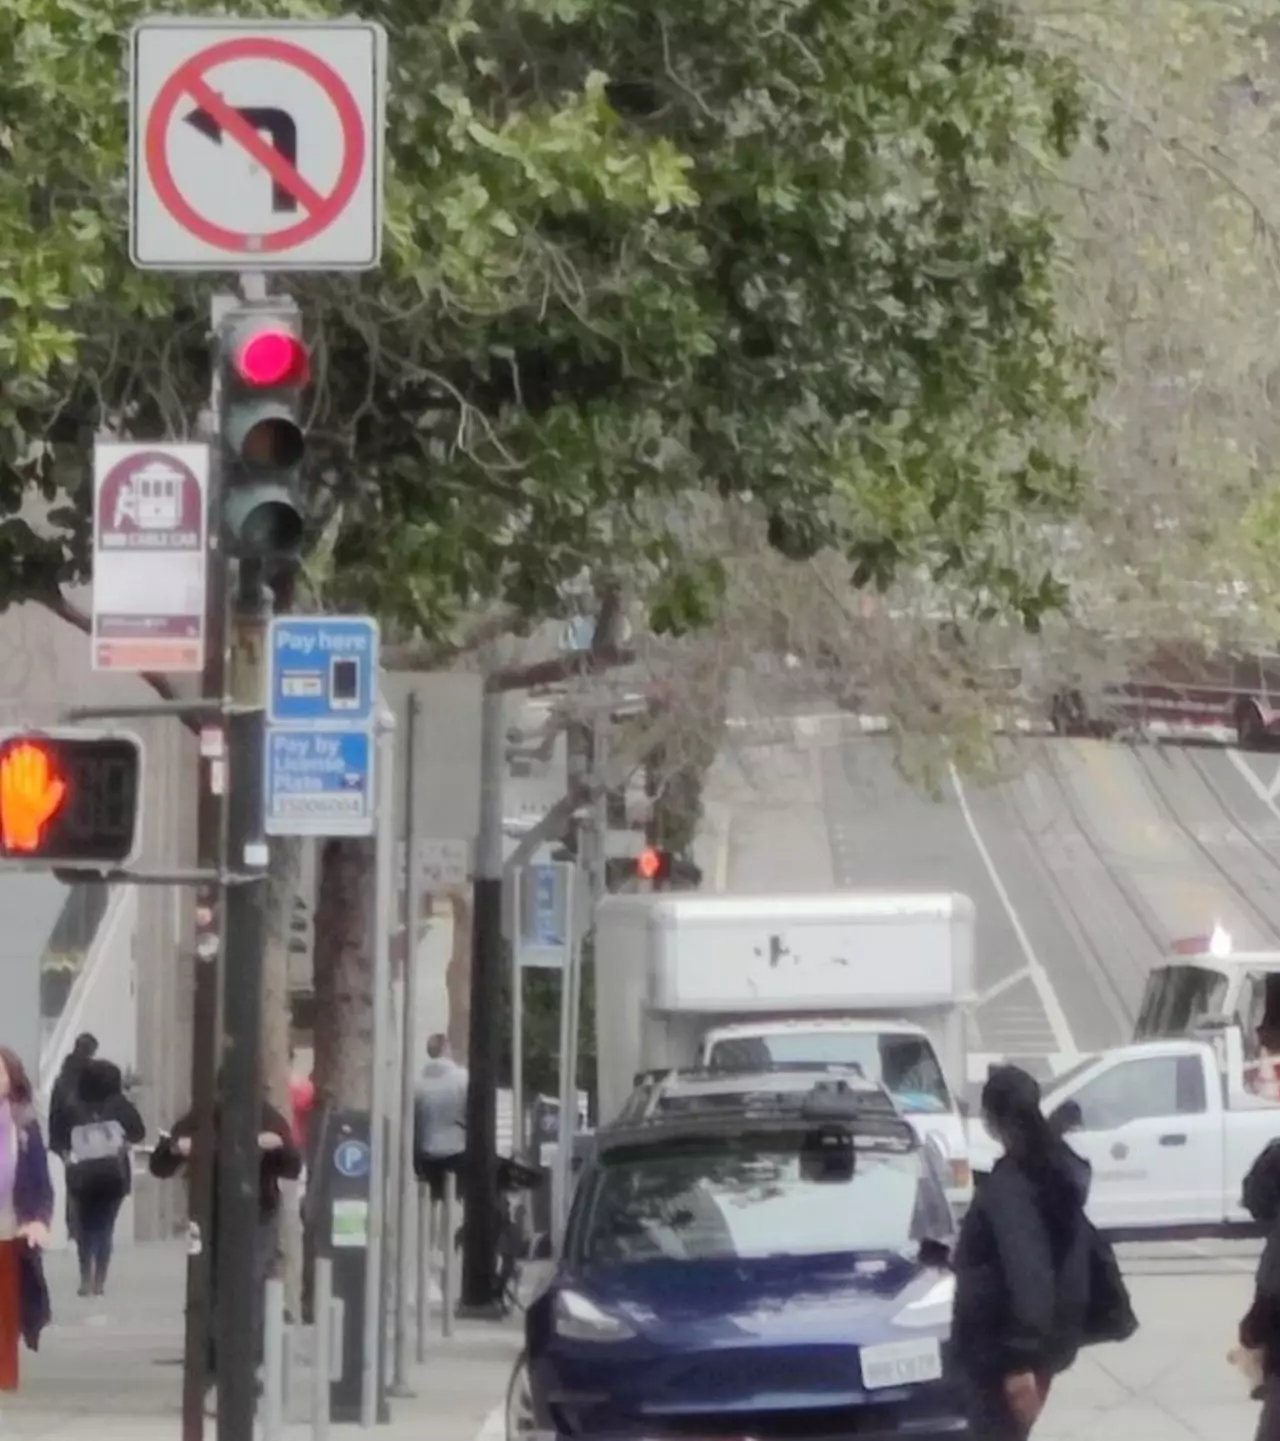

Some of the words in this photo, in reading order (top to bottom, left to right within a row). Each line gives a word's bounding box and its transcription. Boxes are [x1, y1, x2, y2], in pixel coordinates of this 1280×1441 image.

[277, 630, 316, 655] Pay
[318, 630, 367, 650] here
[274, 735, 310, 756] Pay
[315, 735, 342, 757] by
